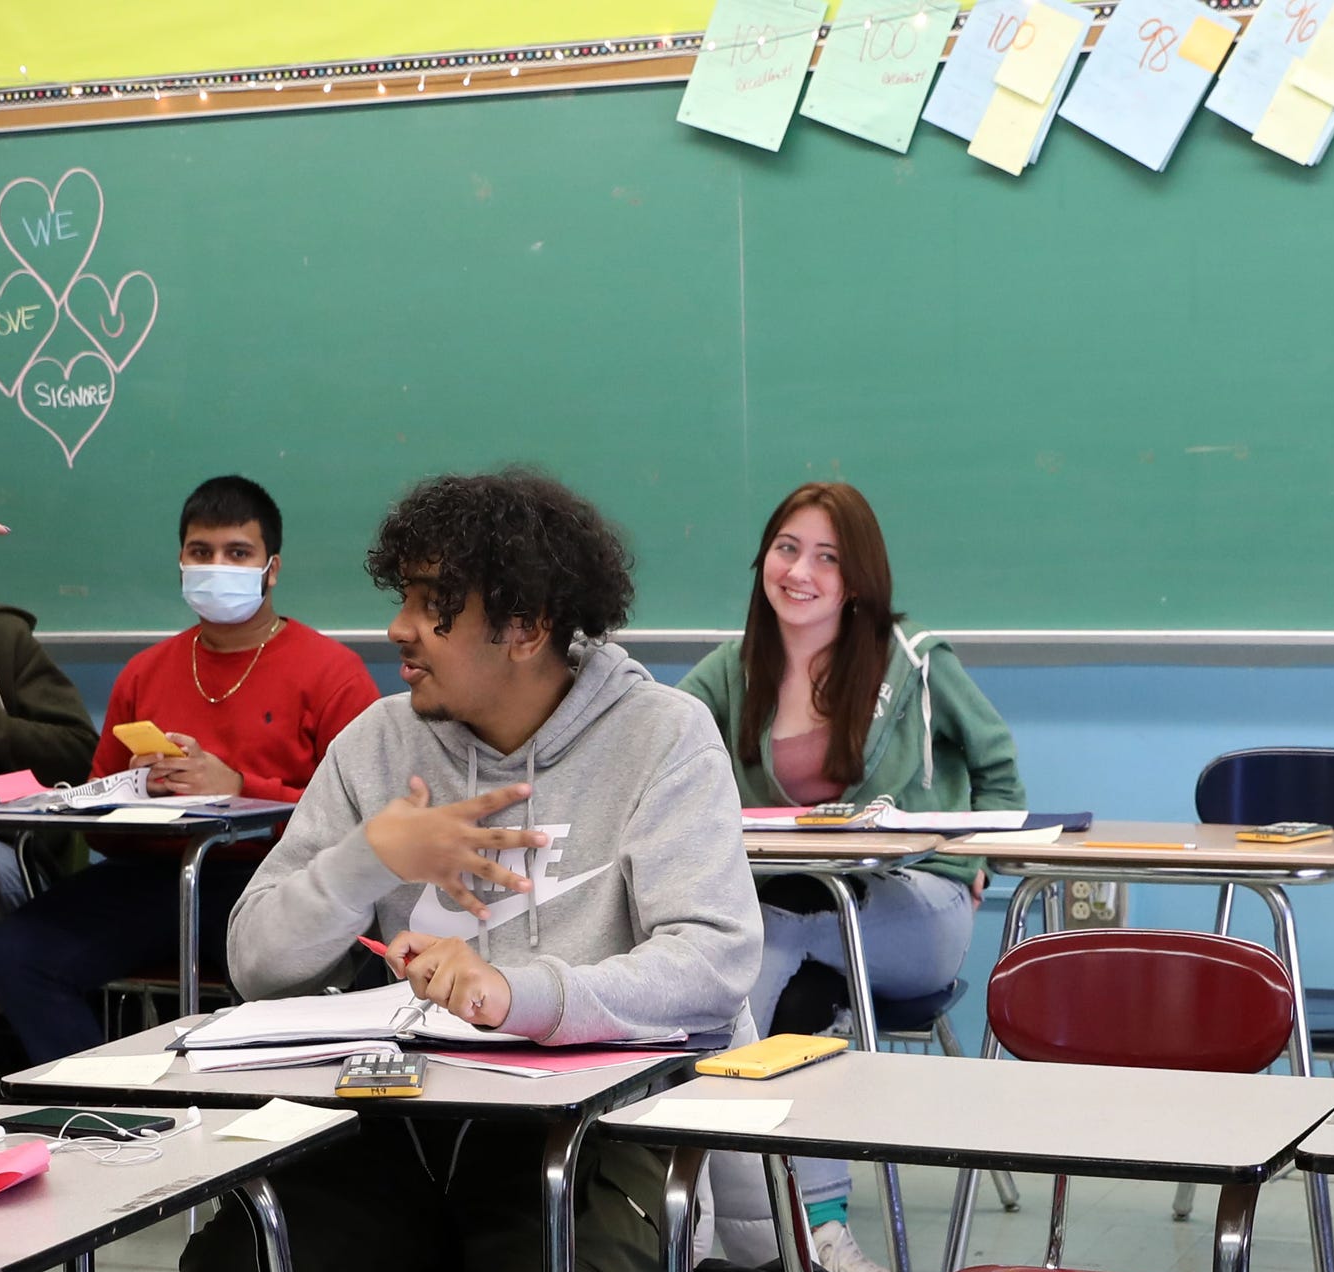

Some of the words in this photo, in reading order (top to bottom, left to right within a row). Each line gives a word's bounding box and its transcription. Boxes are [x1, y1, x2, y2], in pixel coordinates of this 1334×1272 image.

[730, 24, 780, 67] 100
[859, 15, 917, 62] 100
[987, 13, 1036, 53] 100
[1138, 18, 1179, 72] 98
[22, 210, 78, 248] WE
[34, 382, 111, 409] SIGNORE
[440, 823, 571, 892] KE
